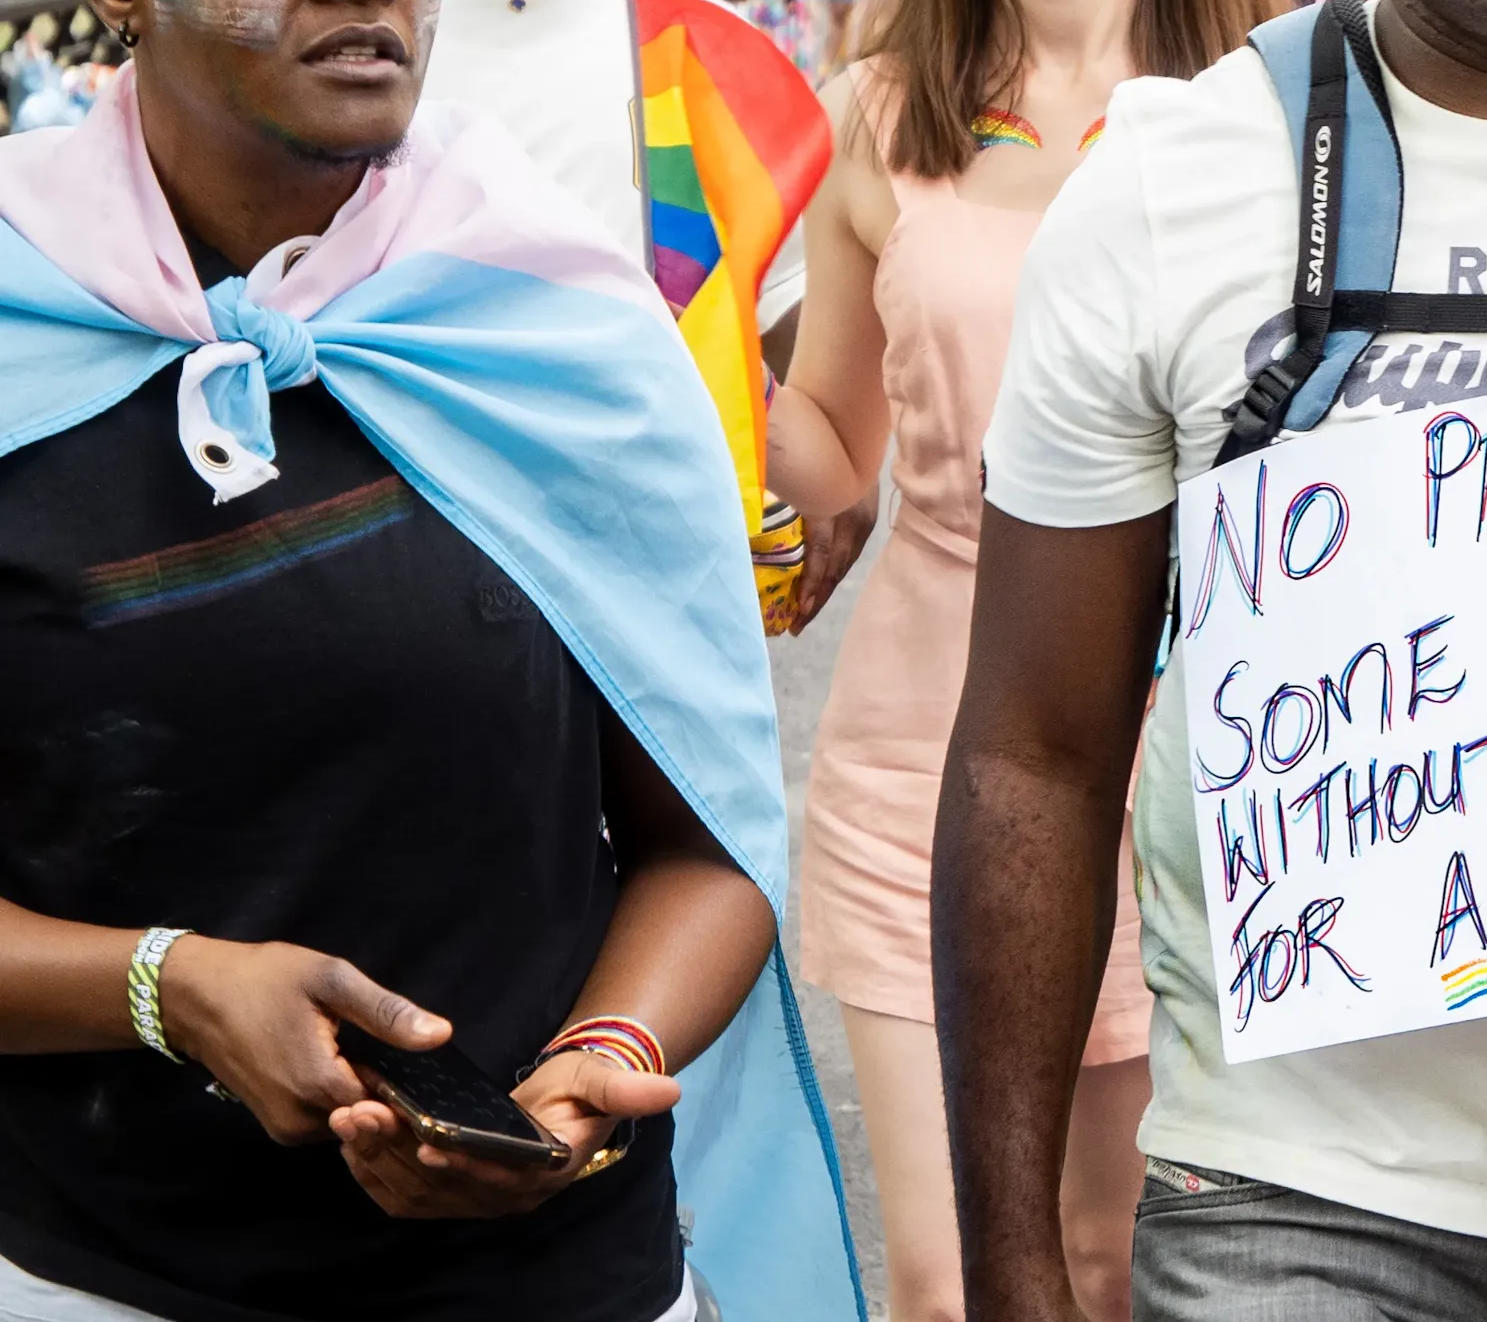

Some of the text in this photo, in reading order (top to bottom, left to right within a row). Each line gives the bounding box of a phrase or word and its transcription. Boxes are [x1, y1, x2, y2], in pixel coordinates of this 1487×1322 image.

[1306, 163, 1330, 297] SALOMON
[1187, 458, 1350, 639] NO
[1194, 613, 1468, 794] SOME
[1228, 881, 1374, 1034] FOR
